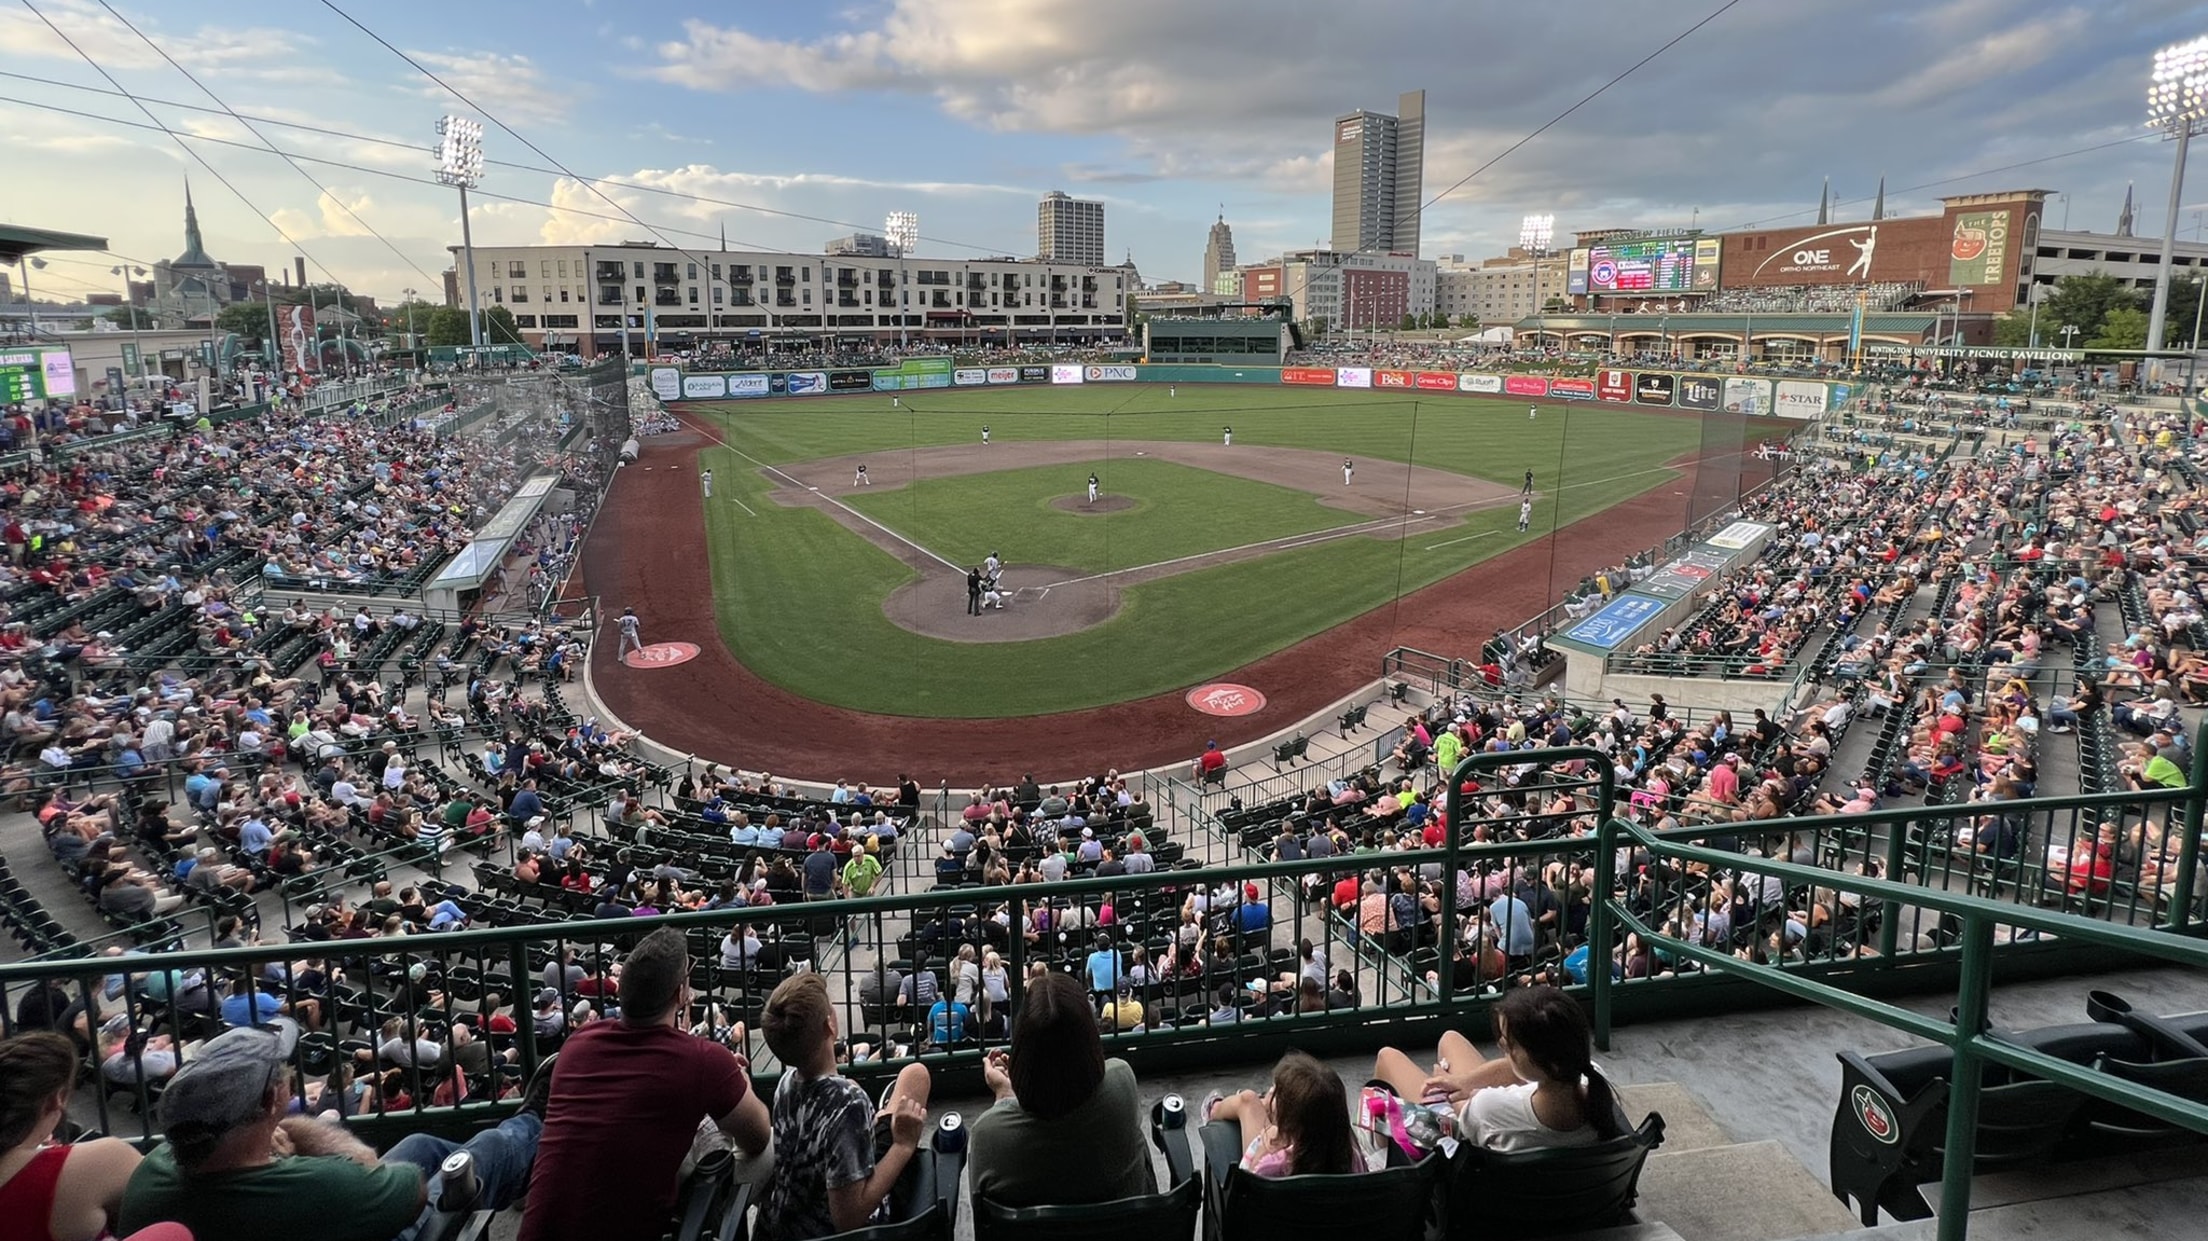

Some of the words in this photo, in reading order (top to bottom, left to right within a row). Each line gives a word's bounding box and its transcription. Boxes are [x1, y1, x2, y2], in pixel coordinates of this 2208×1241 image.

[1984, 211, 2008, 284] TREETOPS
[1793, 249, 1830, 265] ONE
[1870, 345, 1912, 355] HUNTINGTON
[1914, 347, 1965, 357] UNIVERSITY
[1968, 349, 2008, 359] PICNIC
[2011, 351, 2073, 361] PAVILION
[990, 370, 1015, 380] meijer
[1104, 368, 1132, 379] PNC
[1381, 373, 1405, 386] Best
[1682, 380, 1718, 402] Lite
[1790, 394, 1822, 405] STAR
[1223, 698, 1246, 711] Hut
